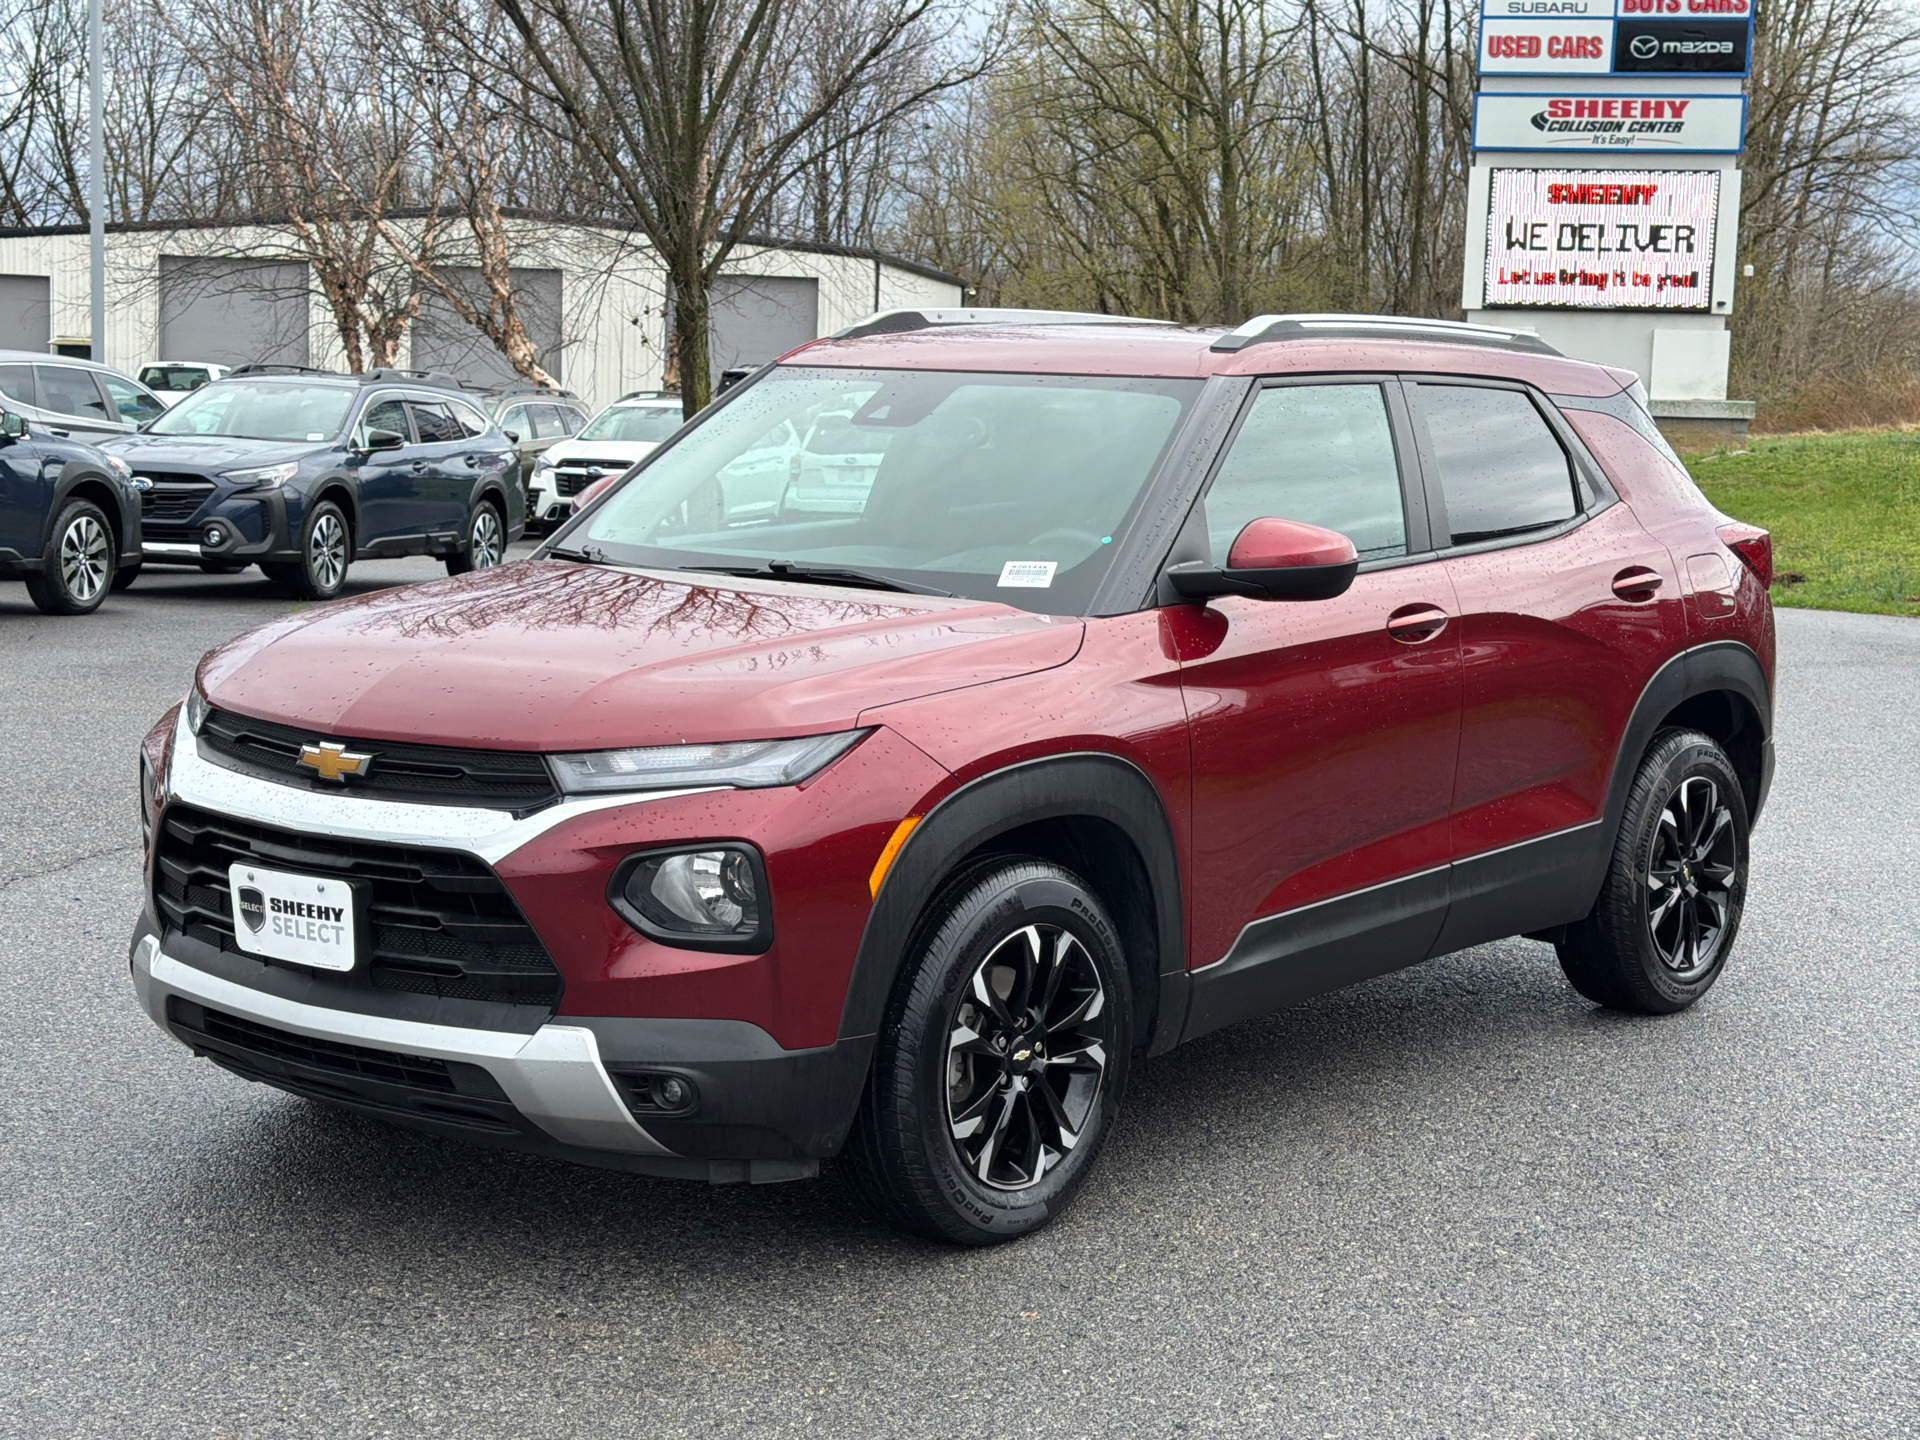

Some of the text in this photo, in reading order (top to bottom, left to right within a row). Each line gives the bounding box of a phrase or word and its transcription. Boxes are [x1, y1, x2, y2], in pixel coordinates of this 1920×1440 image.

[1508, 2, 1588, 13] SUBARU
[1488, 36, 1603, 58] USED CARS
[1662, 41, 1734, 54] mazda
[1547, 99, 1690, 119] SHEEHY
[1547, 120, 1685, 133] COLLISION CENTER
[1592, 134, 1635, 146] It's Easy!
[1505, 221, 1695, 253] WE DELIVER
[240, 901, 265, 914] SELECT
[269, 897, 344, 923] SHEEHY
[272, 915, 345, 946] SELECT
